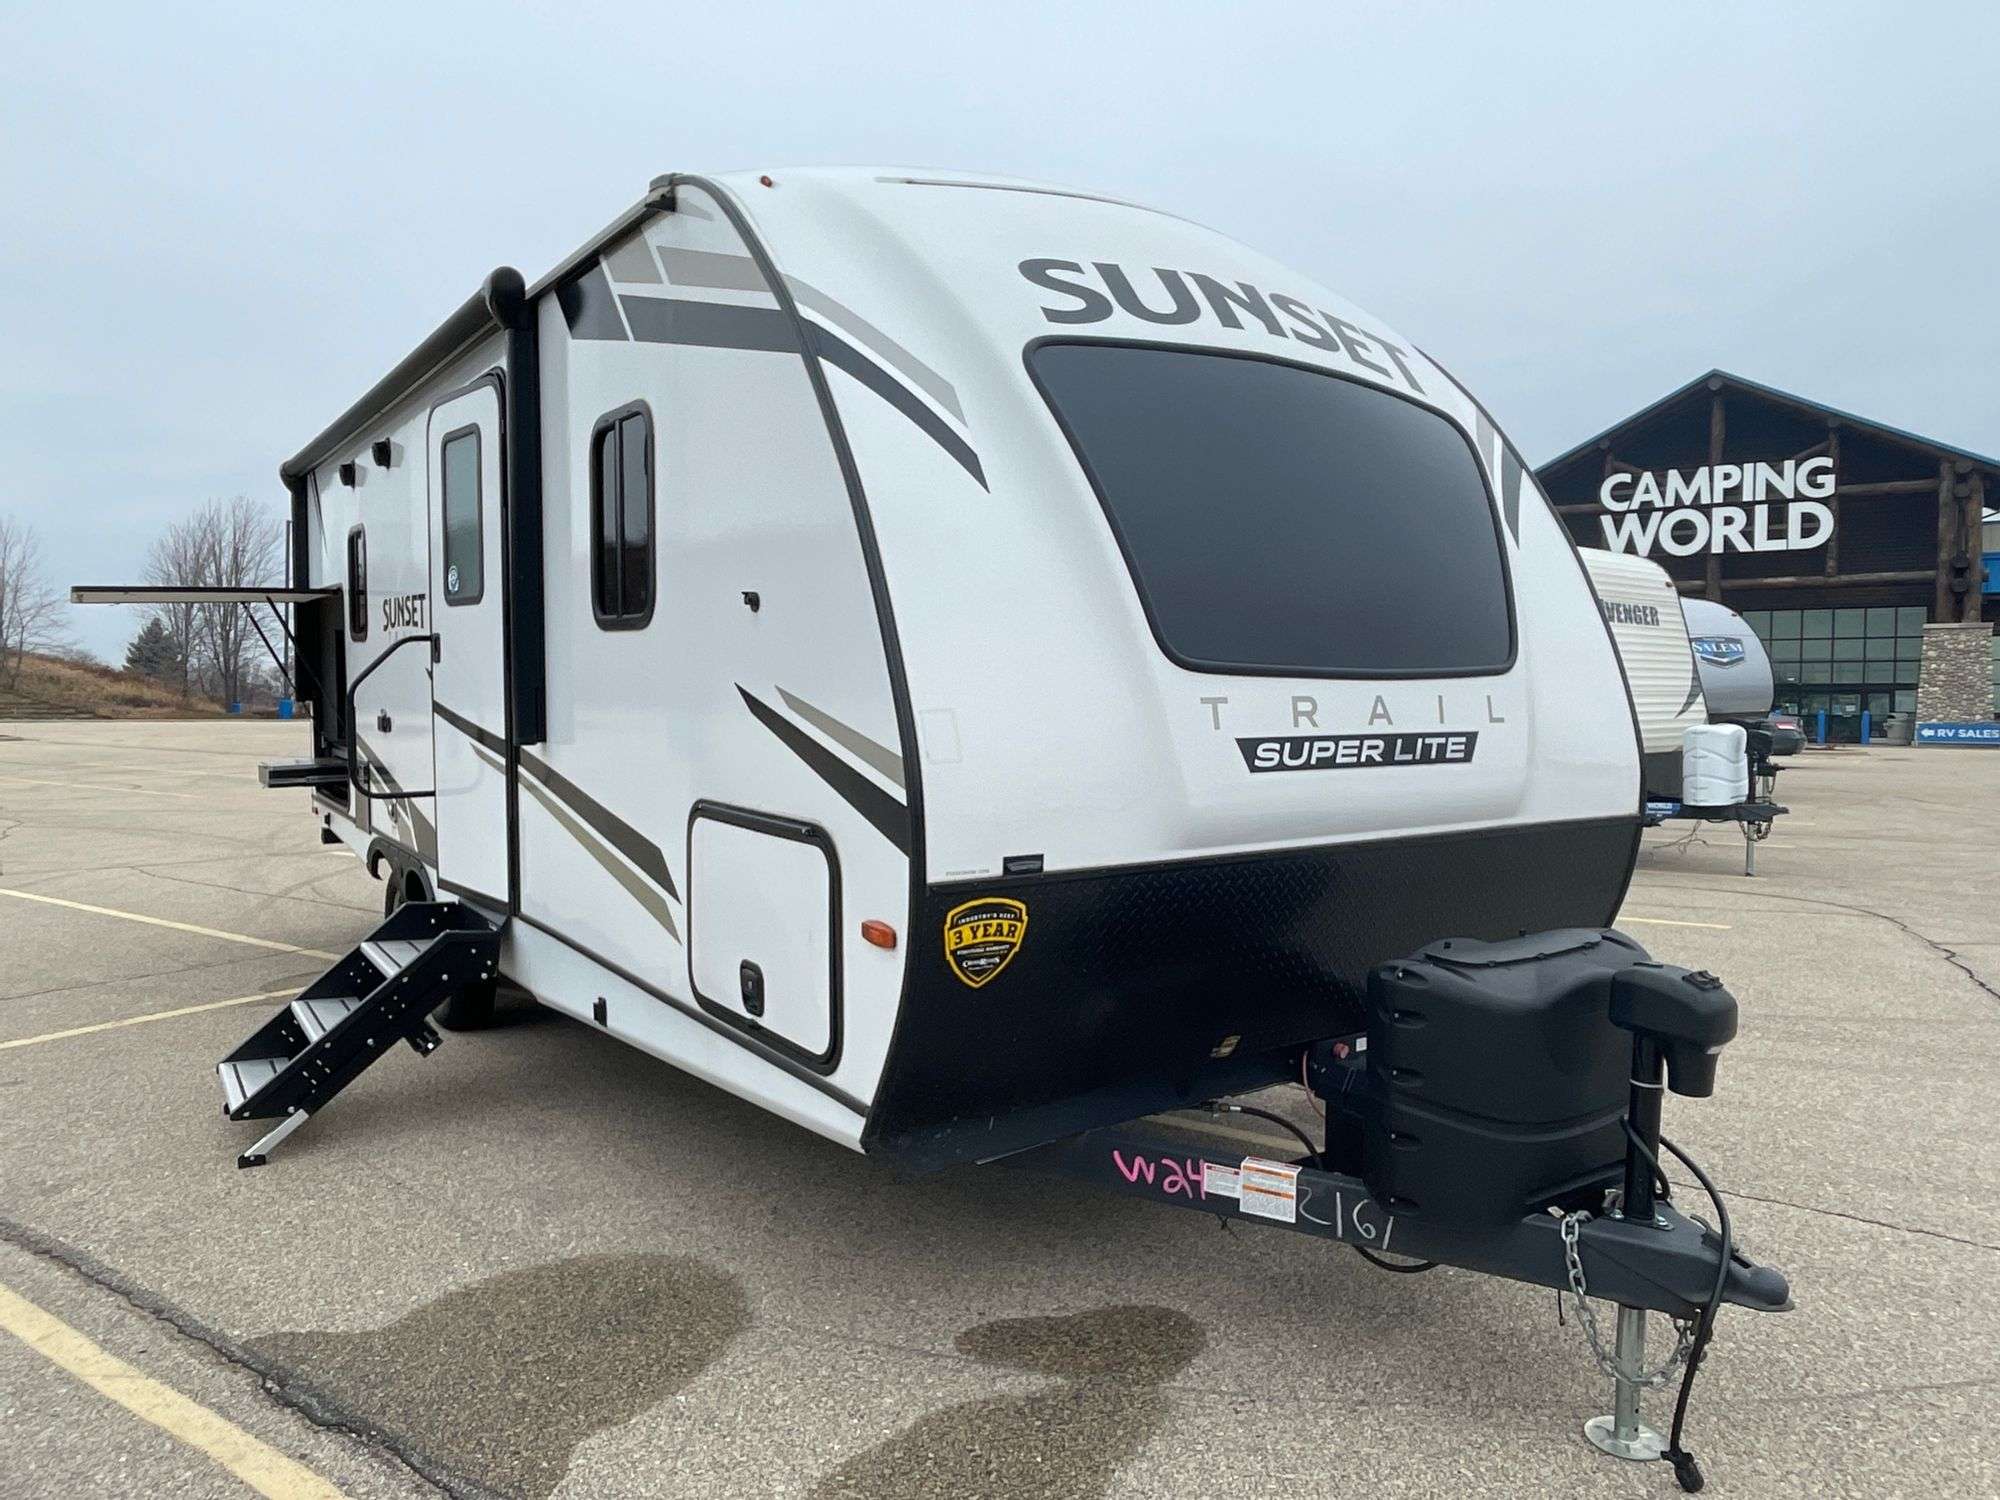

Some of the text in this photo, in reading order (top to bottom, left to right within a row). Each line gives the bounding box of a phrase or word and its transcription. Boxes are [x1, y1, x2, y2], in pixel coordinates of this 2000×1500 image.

[1018, 258, 1427, 396] SUNSET
[1600, 456, 1836, 512] CAMPING
[1600, 501, 1835, 557] WORLD
[382, 593, 426, 632] SUNSET
[1200, 694, 1505, 730] TRAIL
[1937, 728, 2000, 738] RV SALES
[1253, 736, 1467, 768] SUPER LITE
[953, 922, 1019, 946] 3 YEAR
